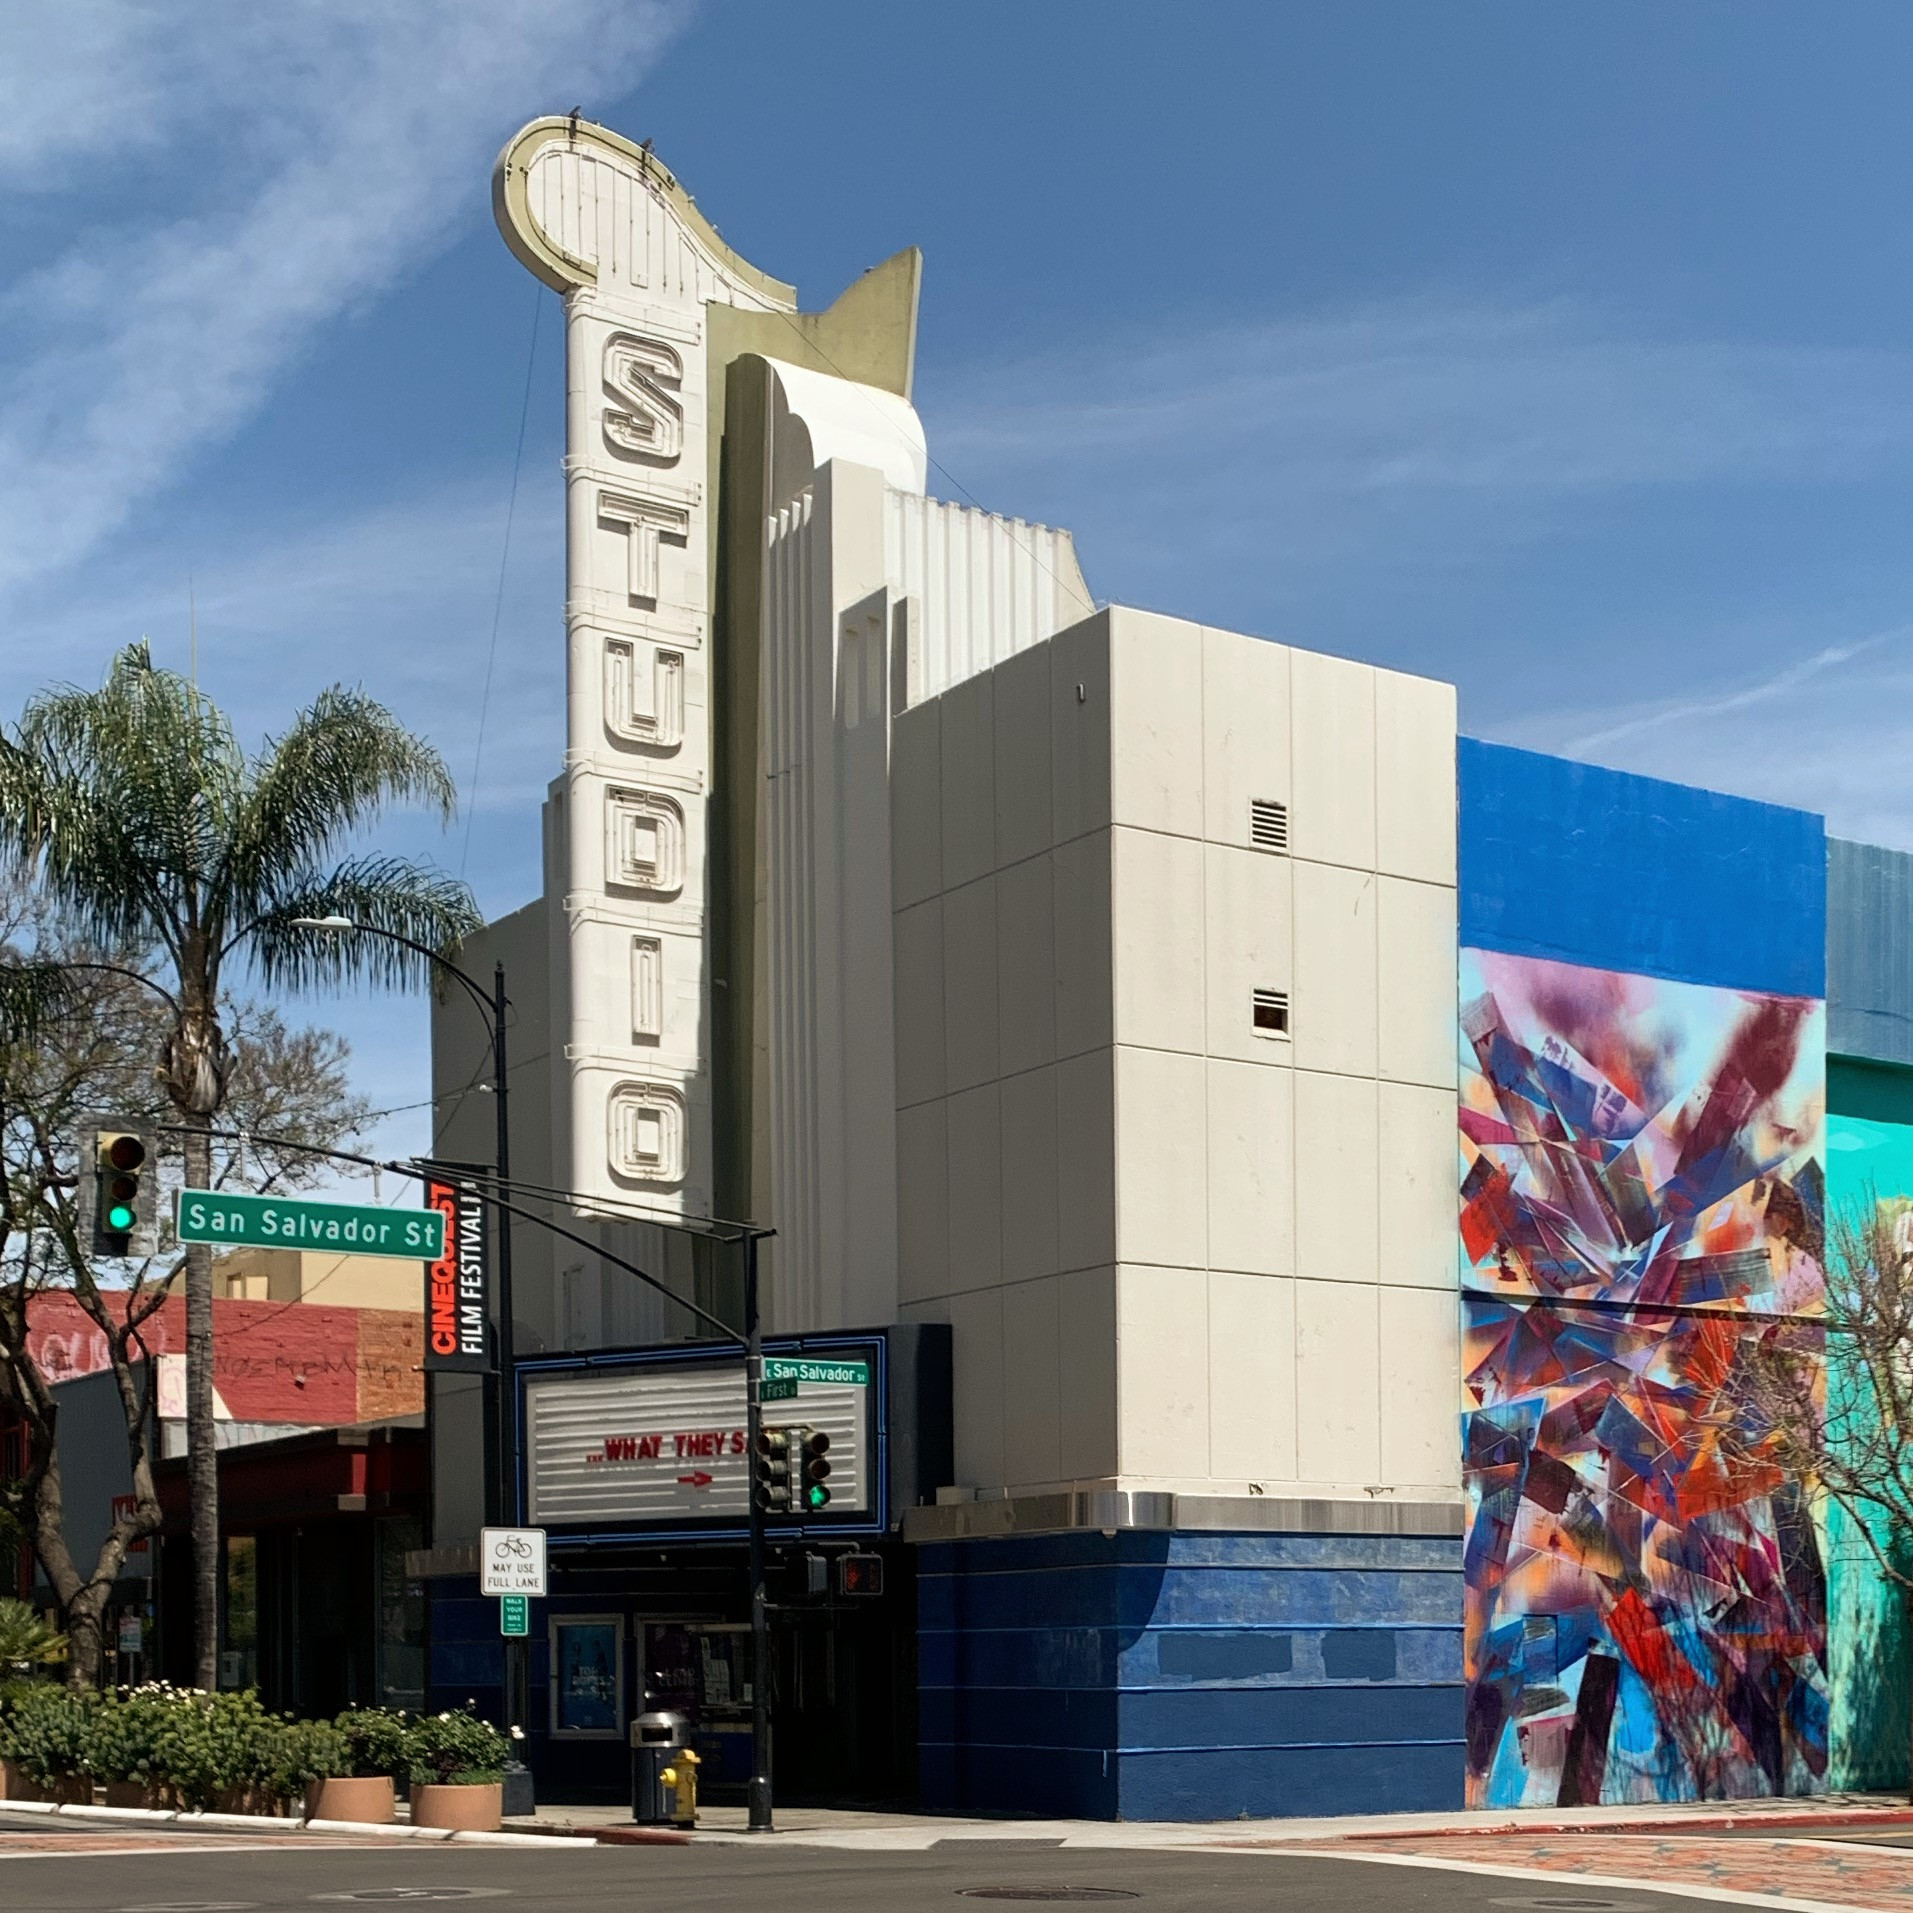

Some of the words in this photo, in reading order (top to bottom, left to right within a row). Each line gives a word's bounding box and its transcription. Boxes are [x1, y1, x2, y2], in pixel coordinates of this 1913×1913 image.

[597, 331, 690, 1193] STUDIO
[188, 1204, 245, 1233] San
[260, 1209, 391, 1244] Salvador
[404, 1221, 436, 1248] St
[460, 1207, 482, 1299] FESTIVAL
[461, 1305, 483, 1354] FILM
[773, 1363, 798, 1378] San
[800, 1364, 856, 1382] Salvador
[766, 1382, 788, 1399] First
[674, 1432, 726, 1458] THEY
[493, 1564, 512, 1573] MAY
[517, 1564, 534, 1573] USE
[488, 1577, 510, 1587] FULL
[515, 1578, 539, 1587] LANE
